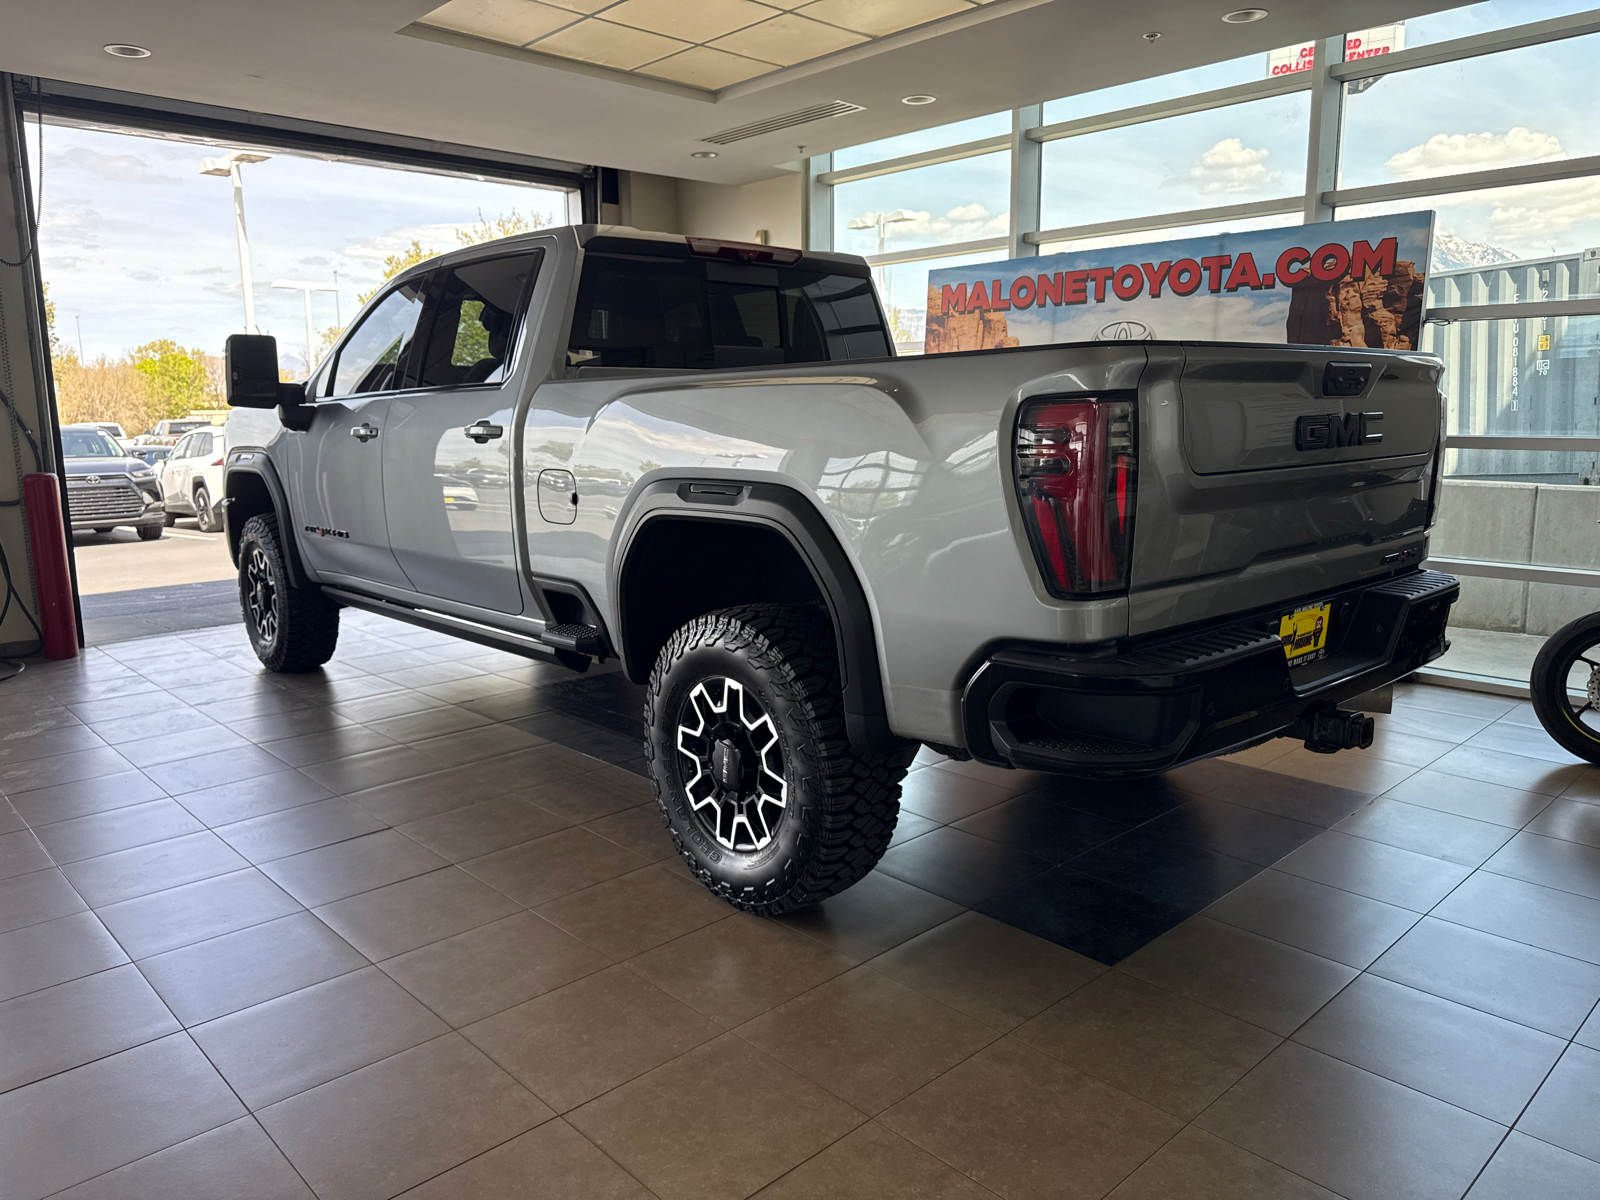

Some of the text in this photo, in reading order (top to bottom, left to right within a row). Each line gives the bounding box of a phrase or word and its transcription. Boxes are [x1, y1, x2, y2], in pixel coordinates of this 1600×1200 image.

[1272, 59, 1313, 75] COLLIS
[1346, 46, 1390, 61] ENTER
[940, 237, 1398, 315] MALONETOYOTA.COM
[1295, 412, 1383, 451] GMC
